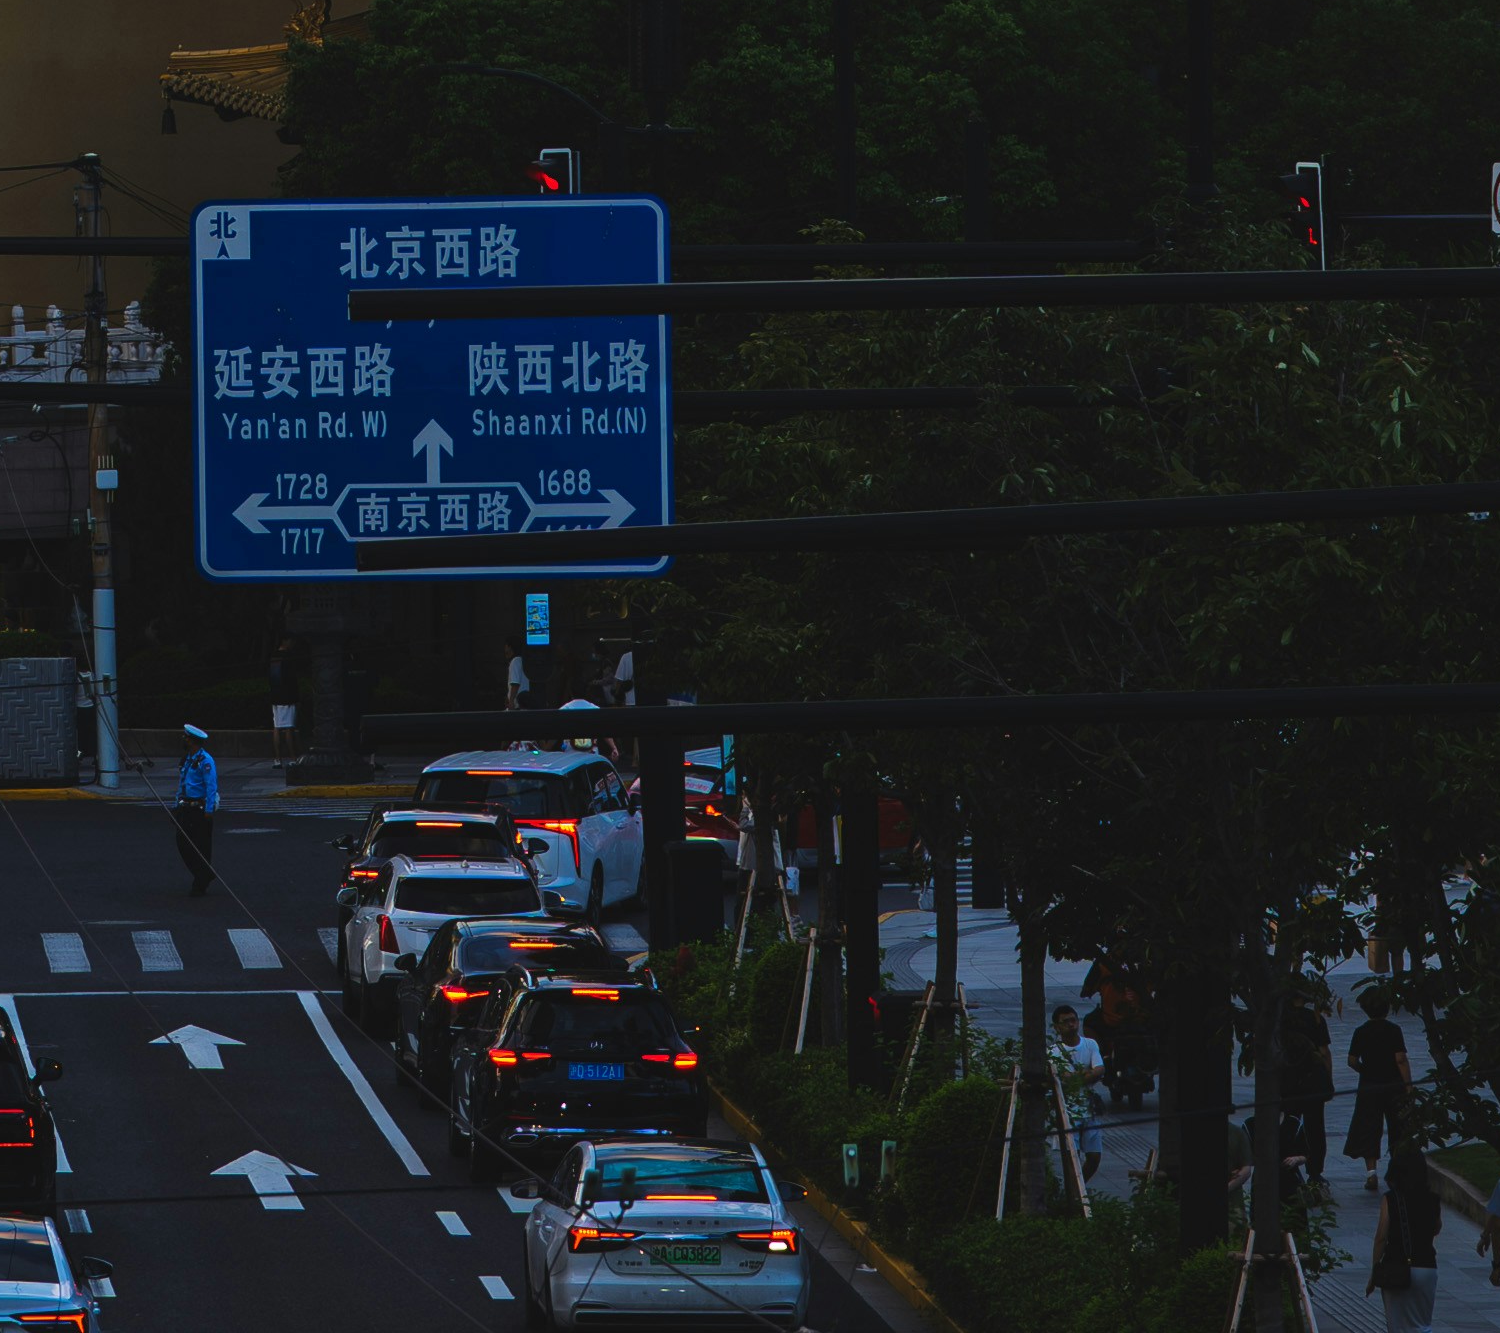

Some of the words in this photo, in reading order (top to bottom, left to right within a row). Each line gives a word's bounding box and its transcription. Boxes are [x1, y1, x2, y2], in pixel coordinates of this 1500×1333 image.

[209, 211, 237, 241] 北
[339, 224, 520, 280] 北京西路
[213, 343, 395, 400] 延安西路
[468, 339, 650, 396] 陕西北路
[222, 411, 308, 440] Yan'an
[318, 410, 354, 438] Rd.
[471, 408, 572, 437] Shaanxi
[581, 406, 647, 436] Rd.(N)
[275, 473, 329, 500] 1728
[538, 468, 592, 496] 1688
[356, 490, 512, 532] 南京西路
[280, 527, 325, 555] 1717
